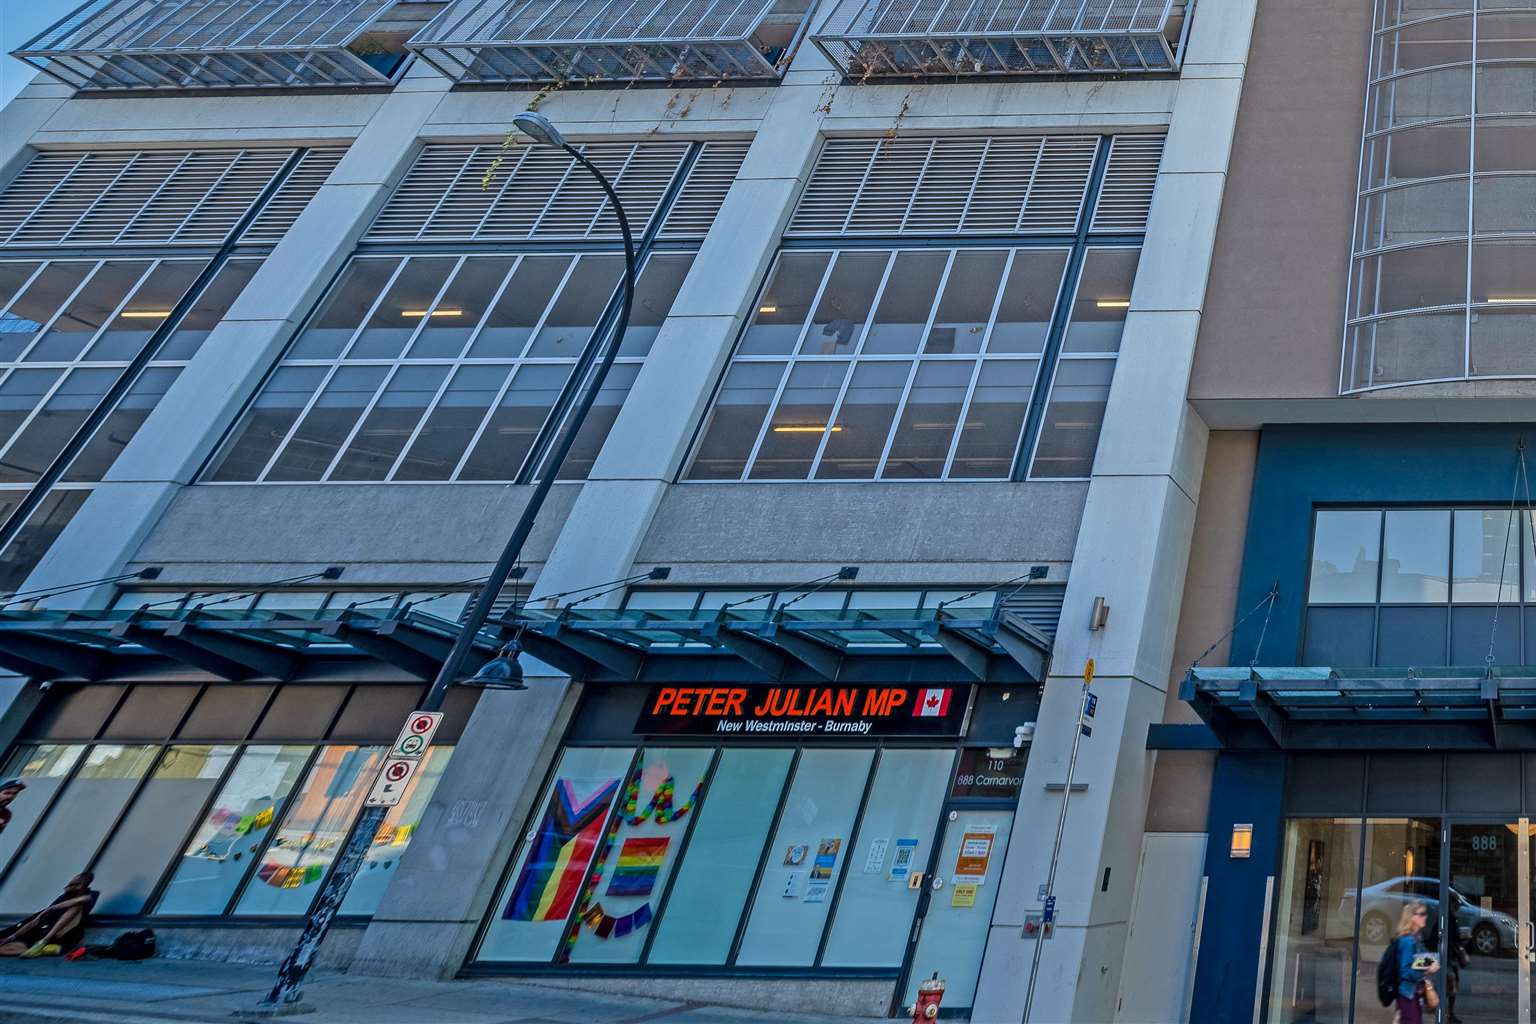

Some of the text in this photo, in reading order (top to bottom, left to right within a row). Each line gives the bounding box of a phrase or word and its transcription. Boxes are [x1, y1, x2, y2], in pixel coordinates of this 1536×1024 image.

[652, 687, 908, 717] PETER JULIAN MP
[716, 719, 744, 732] New
[744, 719, 816, 732] Westminster
[824, 719, 872, 734] Burnaby
[988, 759, 1004, 771] 110
[957, 775, 974, 785] 888
[1471, 835, 1497, 851] 888
